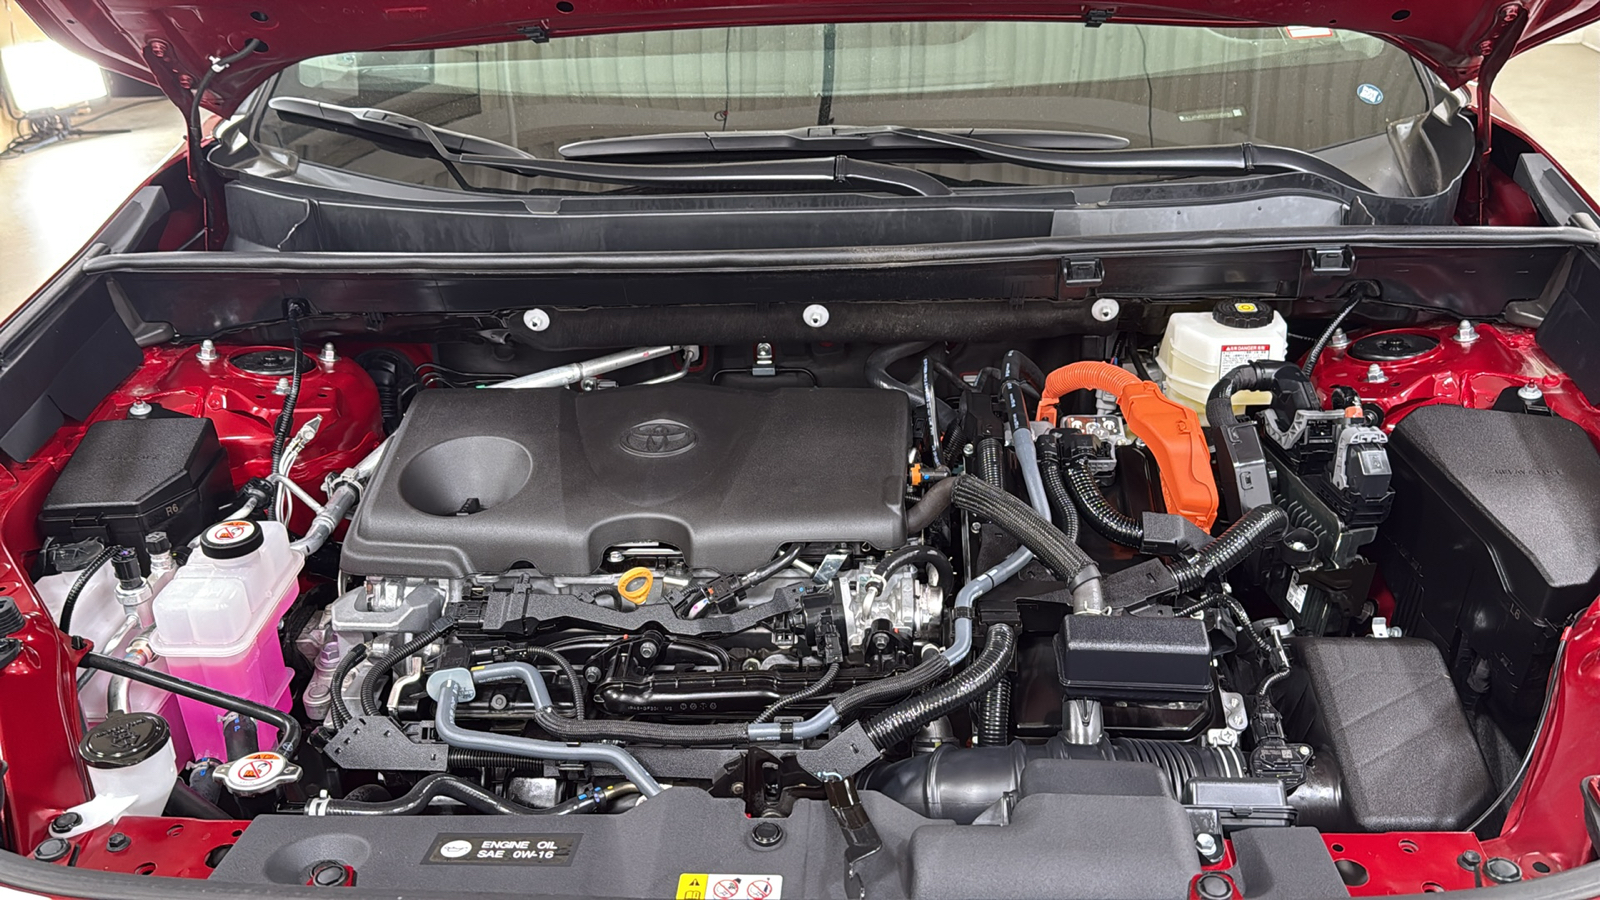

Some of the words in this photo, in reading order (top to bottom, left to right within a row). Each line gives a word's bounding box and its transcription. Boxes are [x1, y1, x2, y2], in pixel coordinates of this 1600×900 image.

[165, 503, 179, 517] R6
[1510, 602, 1521, 620] L6
[481, 840, 530, 849] ENGINE
[537, 840, 558, 850] OIL
[476, 850, 505, 859] SAE
[512, 850, 554, 859] 0W-16
